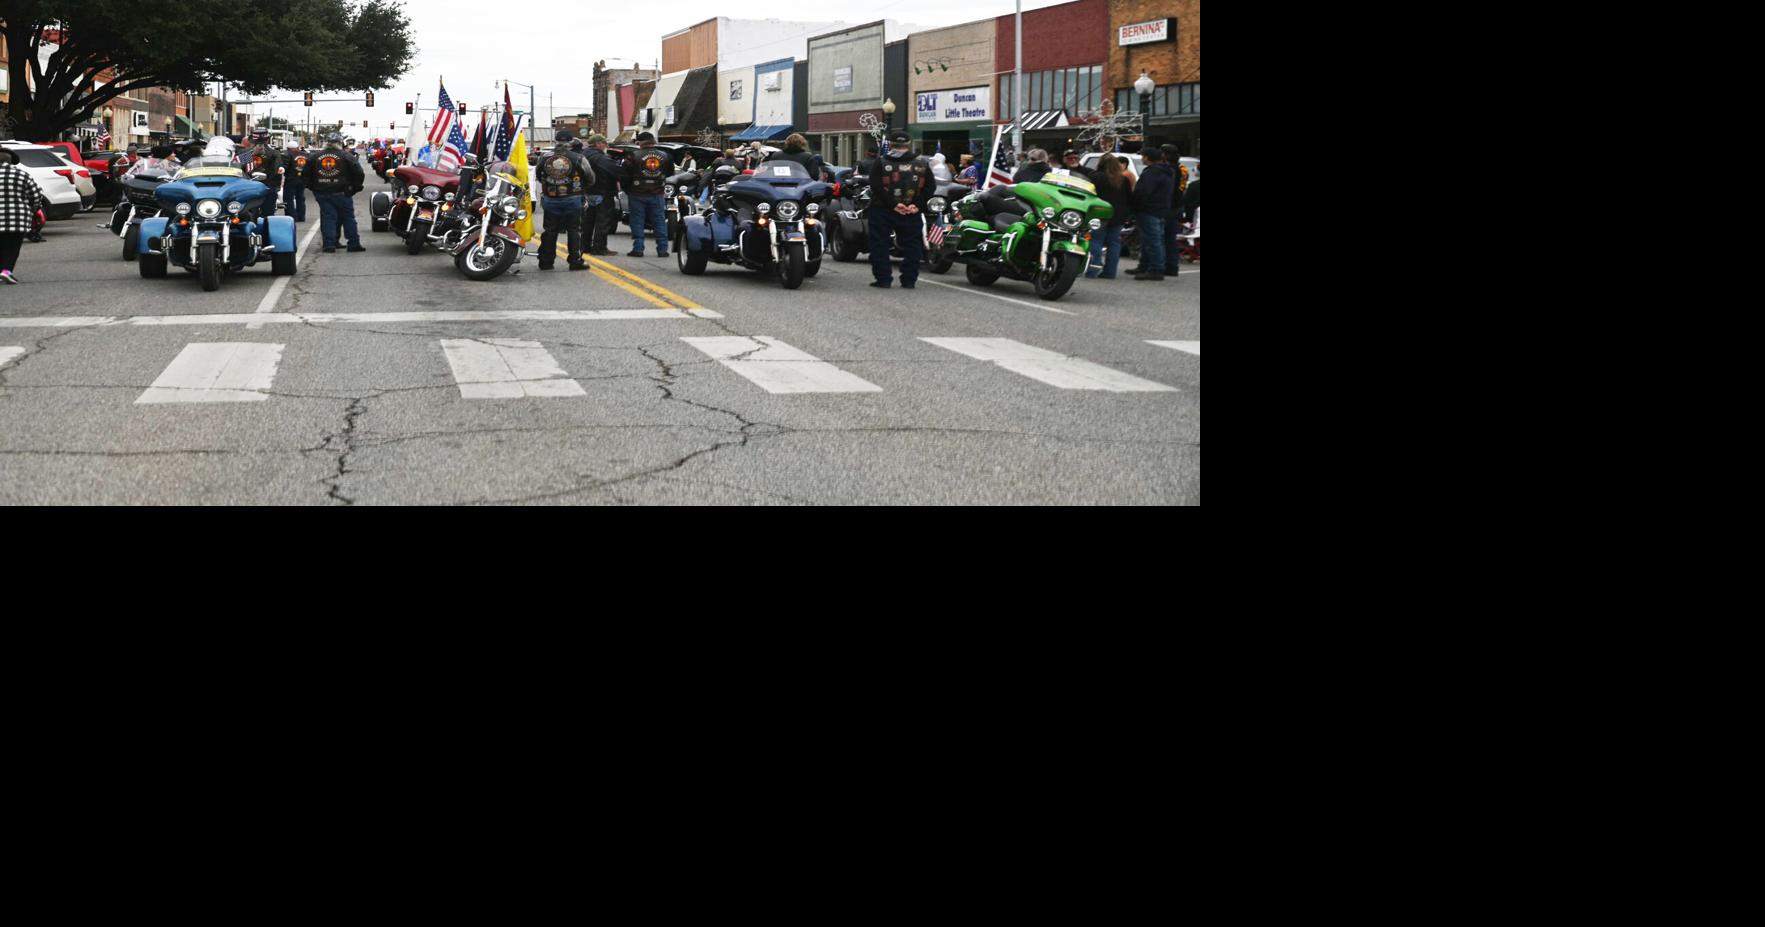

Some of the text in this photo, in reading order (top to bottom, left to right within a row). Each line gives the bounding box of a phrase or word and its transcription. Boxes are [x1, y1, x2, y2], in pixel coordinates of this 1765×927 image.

[1122, 22, 1160, 38] BERNINA
[954, 94, 976, 103] Duncan
[945, 107, 985, 118] Little Theatre
